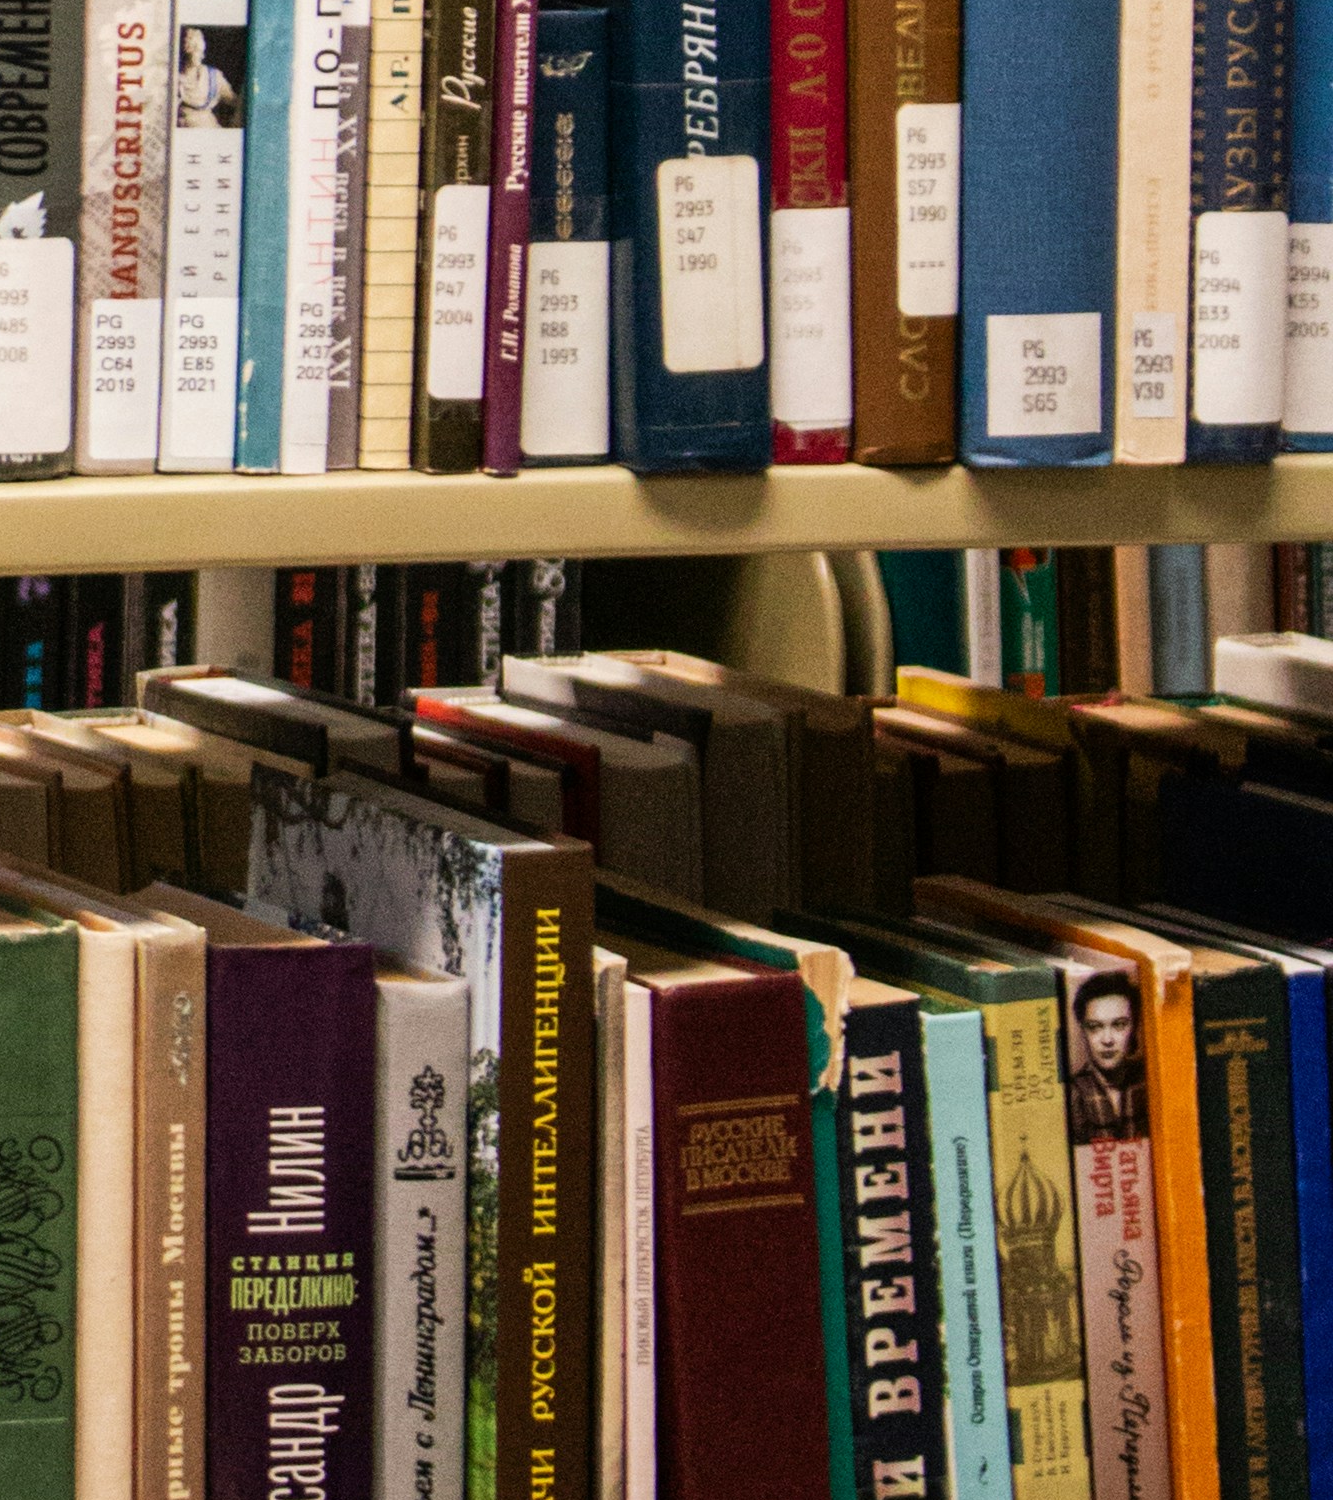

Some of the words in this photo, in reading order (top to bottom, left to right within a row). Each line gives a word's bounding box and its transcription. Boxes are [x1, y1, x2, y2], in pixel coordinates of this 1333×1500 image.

[439, 4, 487, 112] Русские
[507, 12, 531, 107] писатели
[505, 111, 529, 191] Русские
[531, 906, 563, 1222] ИНТЕЛЛИГЕНЦИИ
[246, 1105, 327, 1236] Нилин
[230, 1252, 356, 1271] СТАНЦИЯ
[848, 1051, 923, 1419] ВРЕМЕНИ
[237, 1344, 348, 1364] ЗАБОРОВ
[246, 1321, 342, 1342] ПОВЕРХ
[522, 1259, 558, 1426] РУССКОЙ
